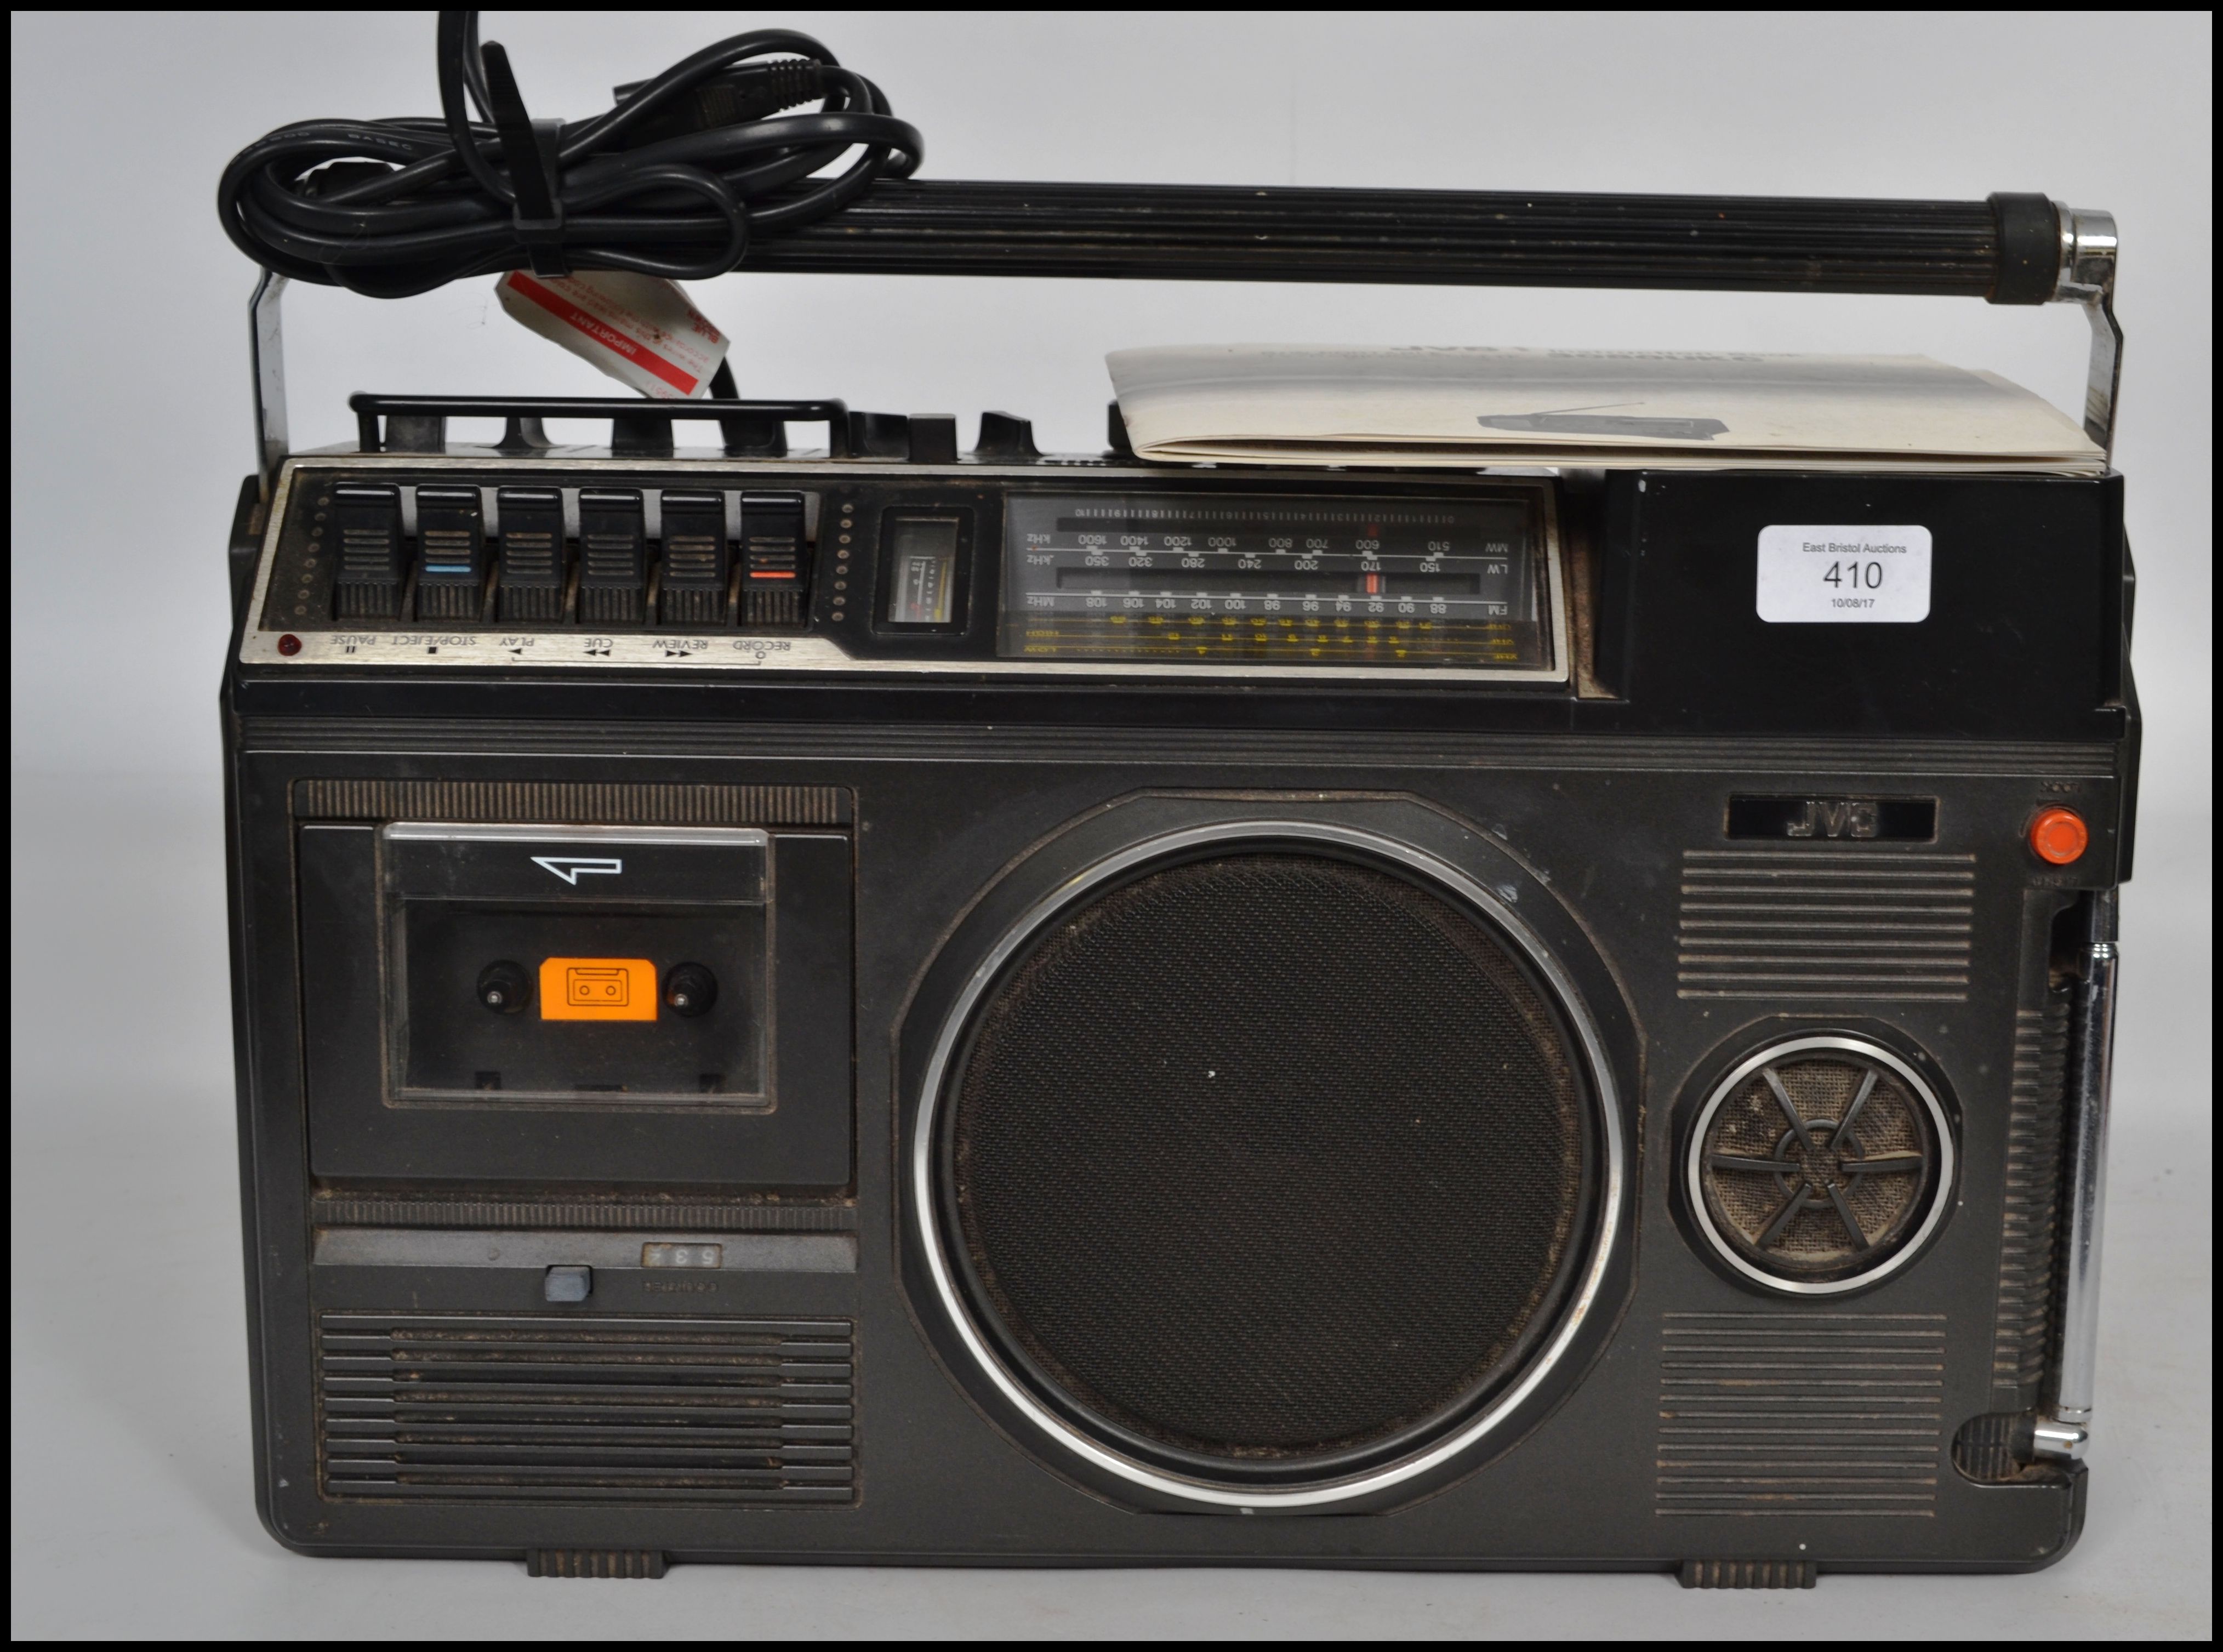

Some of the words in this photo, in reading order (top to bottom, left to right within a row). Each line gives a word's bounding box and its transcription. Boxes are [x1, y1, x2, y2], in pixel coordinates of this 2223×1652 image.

[568, 310, 637, 356] IMPORTANT
[1027, 533, 1051, 544] kHz
[1078, 534, 1107, 545] 1600
[1120, 534, 1149, 545] 1400
[1164, 536, 1192, 546] 1200
[1208, 536, 1236, 546] 1000
[1268, 537, 1293, 548] 800
[1306, 538, 1329, 548] 700
[1355, 539, 1380, 550] 600
[1428, 540, 1451, 551] 510
[1485, 543, 1509, 552] MW
[1803, 543, 1826, 552] East
[1828, 543, 1860, 552] Bristol
[1863, 543, 1906, 554] Auctions
[1027, 554, 1051, 565] kHz
[1085, 555, 1109, 566] 350
[1128, 556, 1153, 567] 320
[1181, 557, 1206, 568] 280
[1238, 558, 1262, 569] 240
[1294, 560, 1319, 570] 200
[1361, 561, 1382, 571] 170
[1420, 562, 1441, 572] 150
[1487, 563, 1508, 574] LW
[1823, 561, 1883, 589] 410
[1027, 596, 1054, 607] MHz
[1086, 597, 1108, 607] 108
[1124, 597, 1144, 608] 106
[1155, 598, 1177, 608] 104
[1190, 598, 1212, 609] 102
[1224, 599, 1246, 609] 100
[1264, 600, 1280, 610] 98
[1302, 601, 1319, 611] 96
[1336, 601, 1352, 612] 94
[1831, 599, 1874, 608] 10/08/17
[1368, 602, 1384, 613] 92
[1398, 602, 1416, 613] 90
[1430, 603, 1447, 614] 88
[1487, 605, 1508, 616] FM
[330, 634, 377, 646] PAUSE
[391, 634, 477, 647] STOP/EJECT
[499, 636, 534, 648] PLAY
[584, 637, 614, 648] CUE
[652, 638, 709, 650] REVIEW
[732, 639, 791, 651] RECORD
[1785, 800, 1879, 838] JVC
